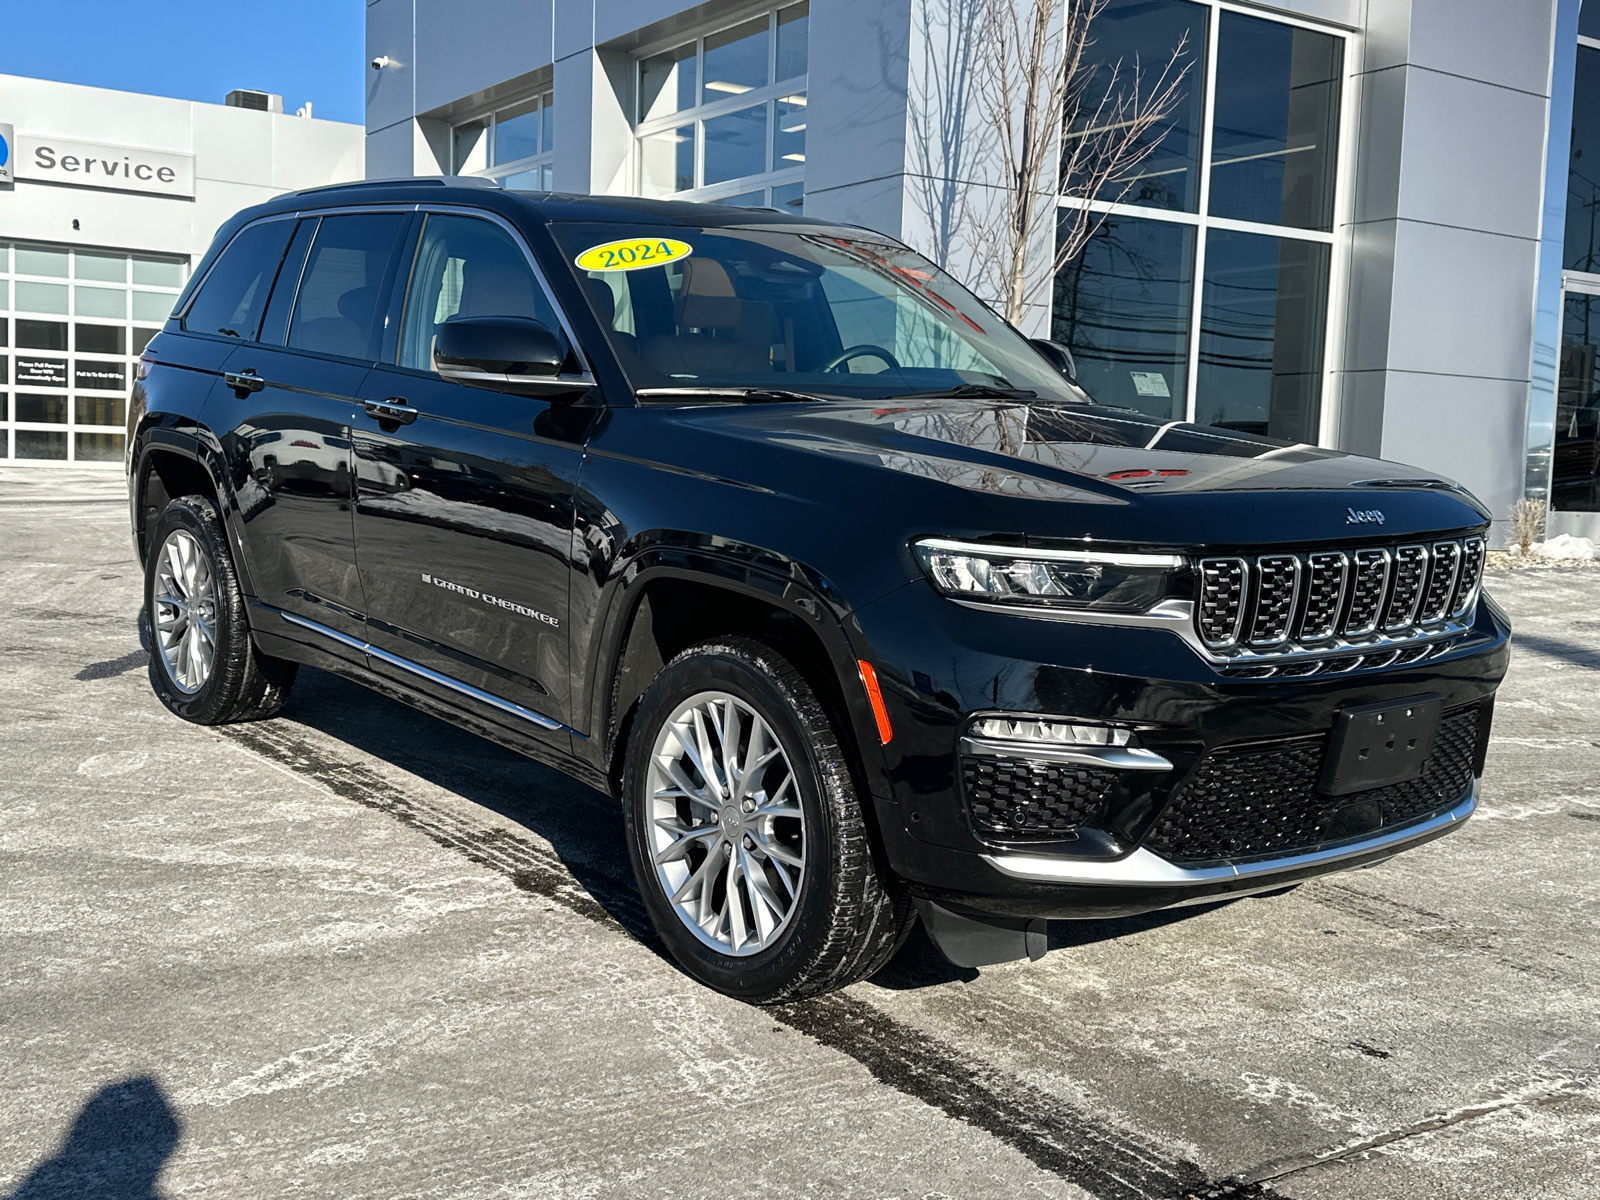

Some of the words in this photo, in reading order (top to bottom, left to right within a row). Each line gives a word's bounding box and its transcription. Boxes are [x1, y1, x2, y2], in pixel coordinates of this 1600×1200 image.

[34, 146, 176, 183] Service
[599, 241, 674, 268] 2024
[1346, 507, 1385, 525] Jeep
[433, 577, 479, 599] GRAND
[482, 593, 559, 628] CHEROKEE
